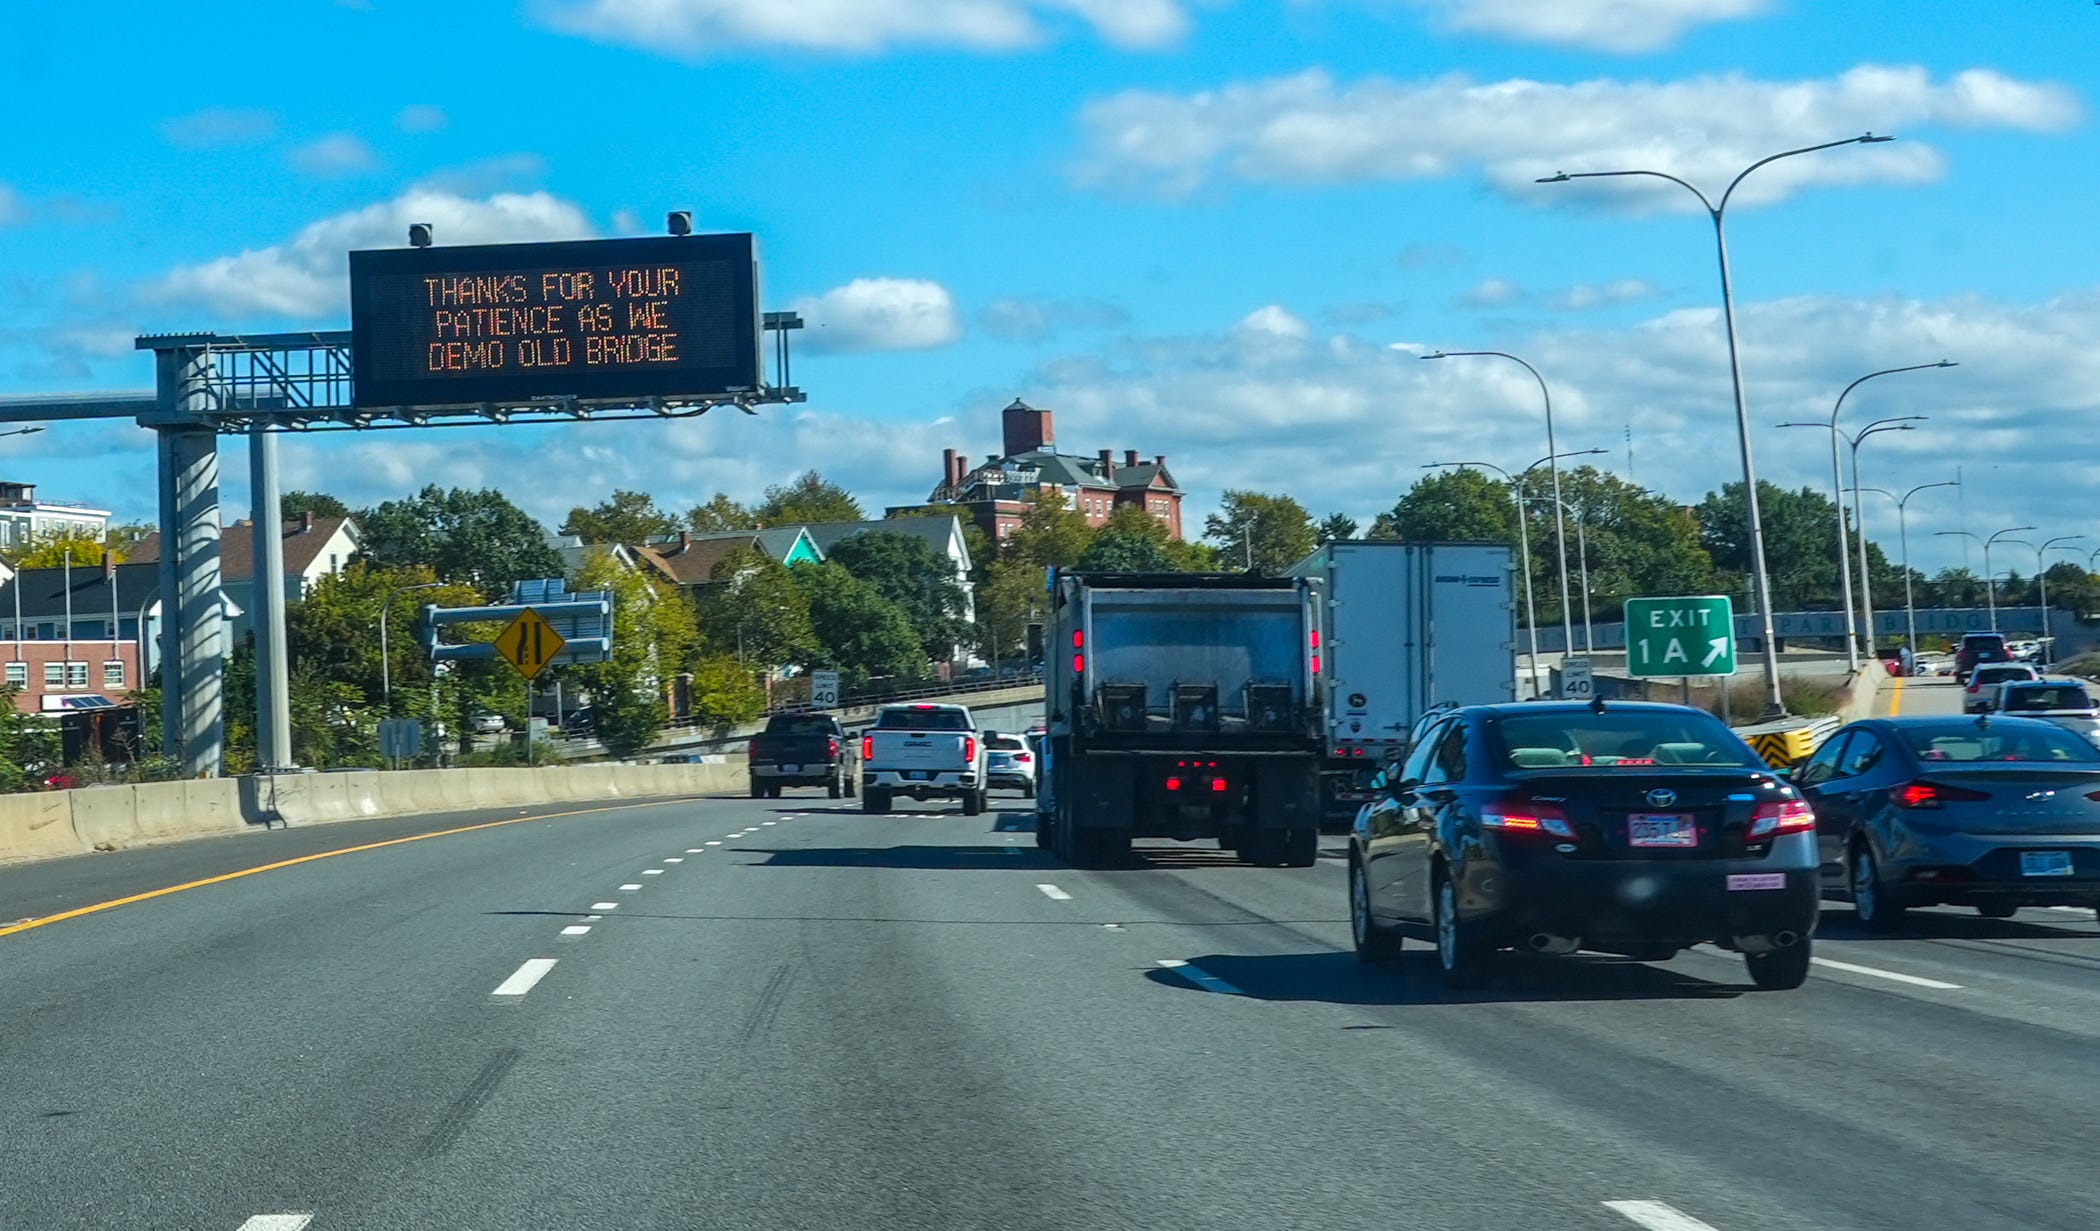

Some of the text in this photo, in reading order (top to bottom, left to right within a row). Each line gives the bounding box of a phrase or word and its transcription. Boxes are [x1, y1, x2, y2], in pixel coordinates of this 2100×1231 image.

[423, 267, 680, 307] THANKS FOR YOUR
[436, 300, 669, 338] PATIENCE AS WE
[428, 333, 680, 371] DEMO OLD BRIDGE
[1650, 608, 1712, 629] EXIT
[1638, 637, 1689, 665] 1 A
[814, 691, 836, 704] 40
[1565, 680, 1590, 694] 40
[903, 740, 934, 748] GMC
